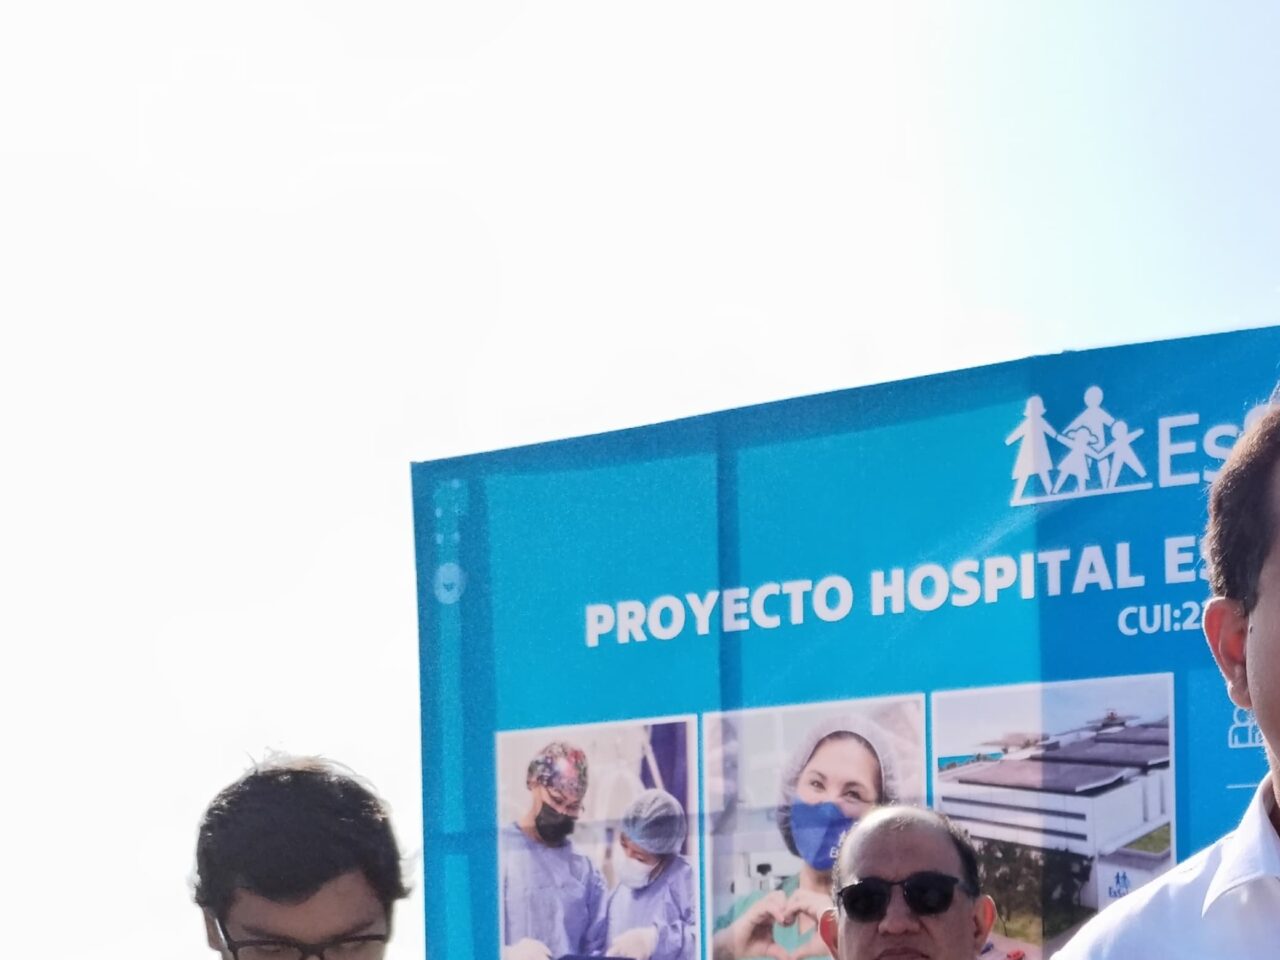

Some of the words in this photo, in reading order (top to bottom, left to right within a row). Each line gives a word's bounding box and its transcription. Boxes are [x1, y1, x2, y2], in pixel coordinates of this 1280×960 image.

[584, 574, 854, 648] PROYECTO
[870, 541, 1146, 617] HOSPITAL
[1117, 601, 1205, 636] CUI:2
